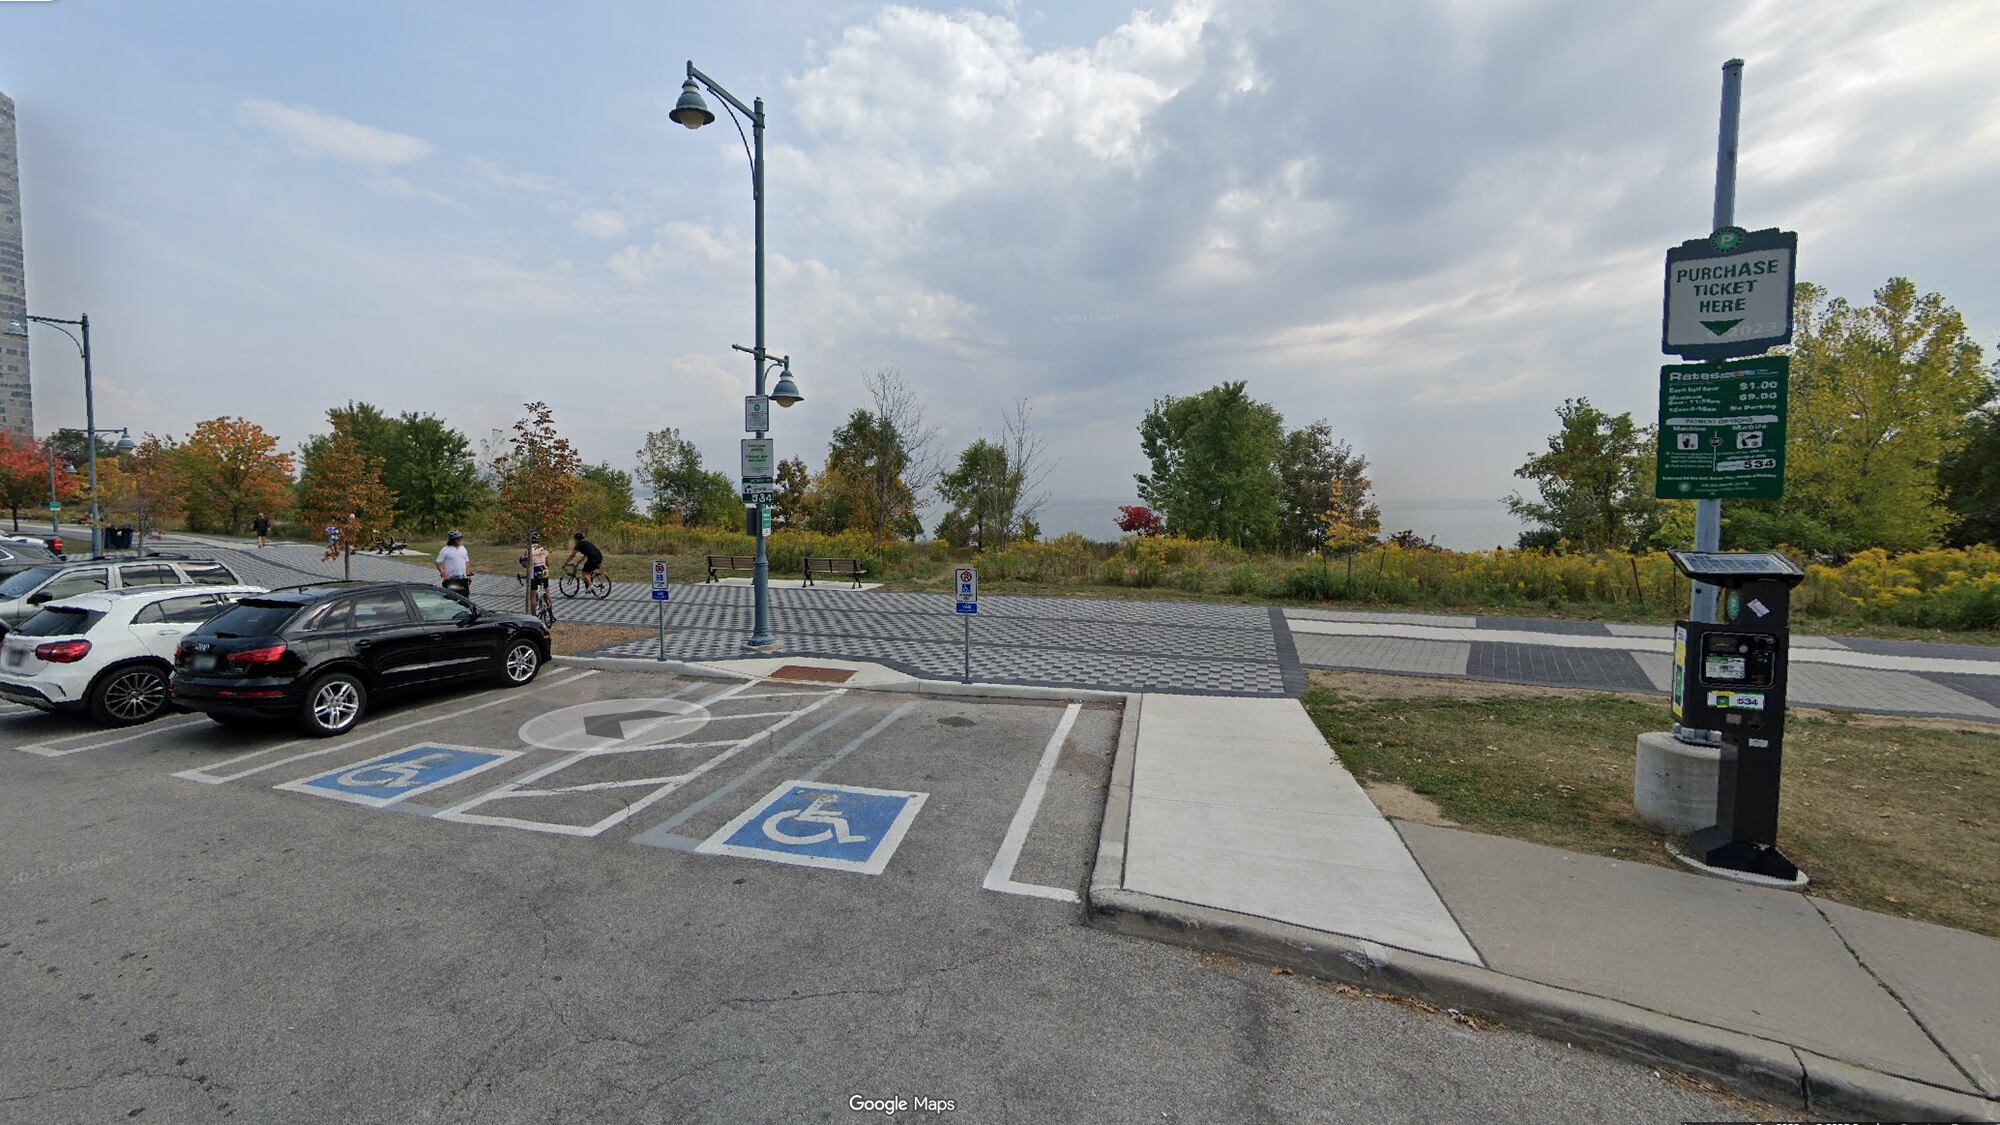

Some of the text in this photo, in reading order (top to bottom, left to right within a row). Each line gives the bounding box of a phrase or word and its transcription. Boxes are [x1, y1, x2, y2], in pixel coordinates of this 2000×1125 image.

[1676, 260, 1778, 282] PURCHASE
[1693, 280, 1757, 296] TICKET
[1700, 298, 1747, 313] HERE
[1740, 381, 1778, 390] $1.00
[1743, 459, 1774, 469] 534
[752, 493, 772, 502] 534
